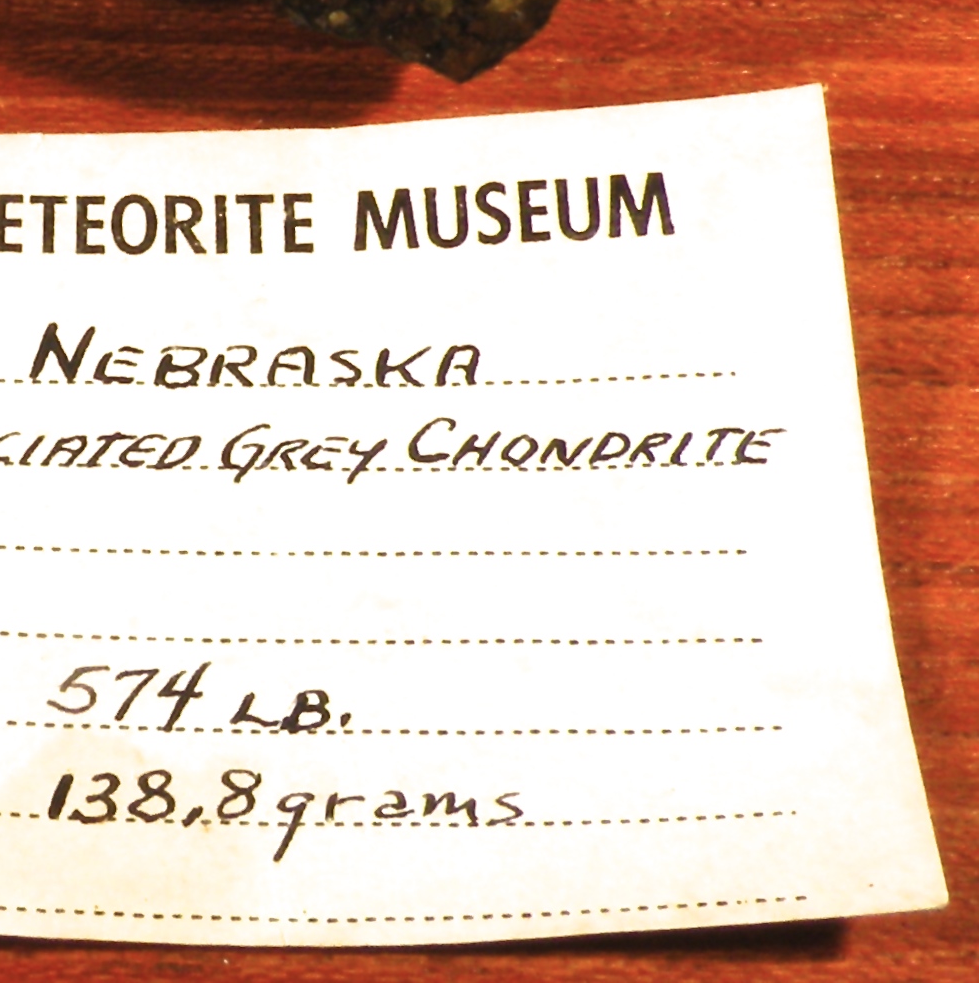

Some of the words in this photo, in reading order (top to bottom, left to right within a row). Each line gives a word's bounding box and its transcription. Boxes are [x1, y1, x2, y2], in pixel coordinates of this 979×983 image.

[354, 172, 675, 251] MUSEUM
[29, 323, 482, 388] NEBRASKA
[220, 423, 388, 483] GREY
[407, 417, 787, 467] CHONDRITE
[47, 662, 211, 731] 574
[230, 689, 352, 734] LB.
[273, 791, 525, 863] grams
